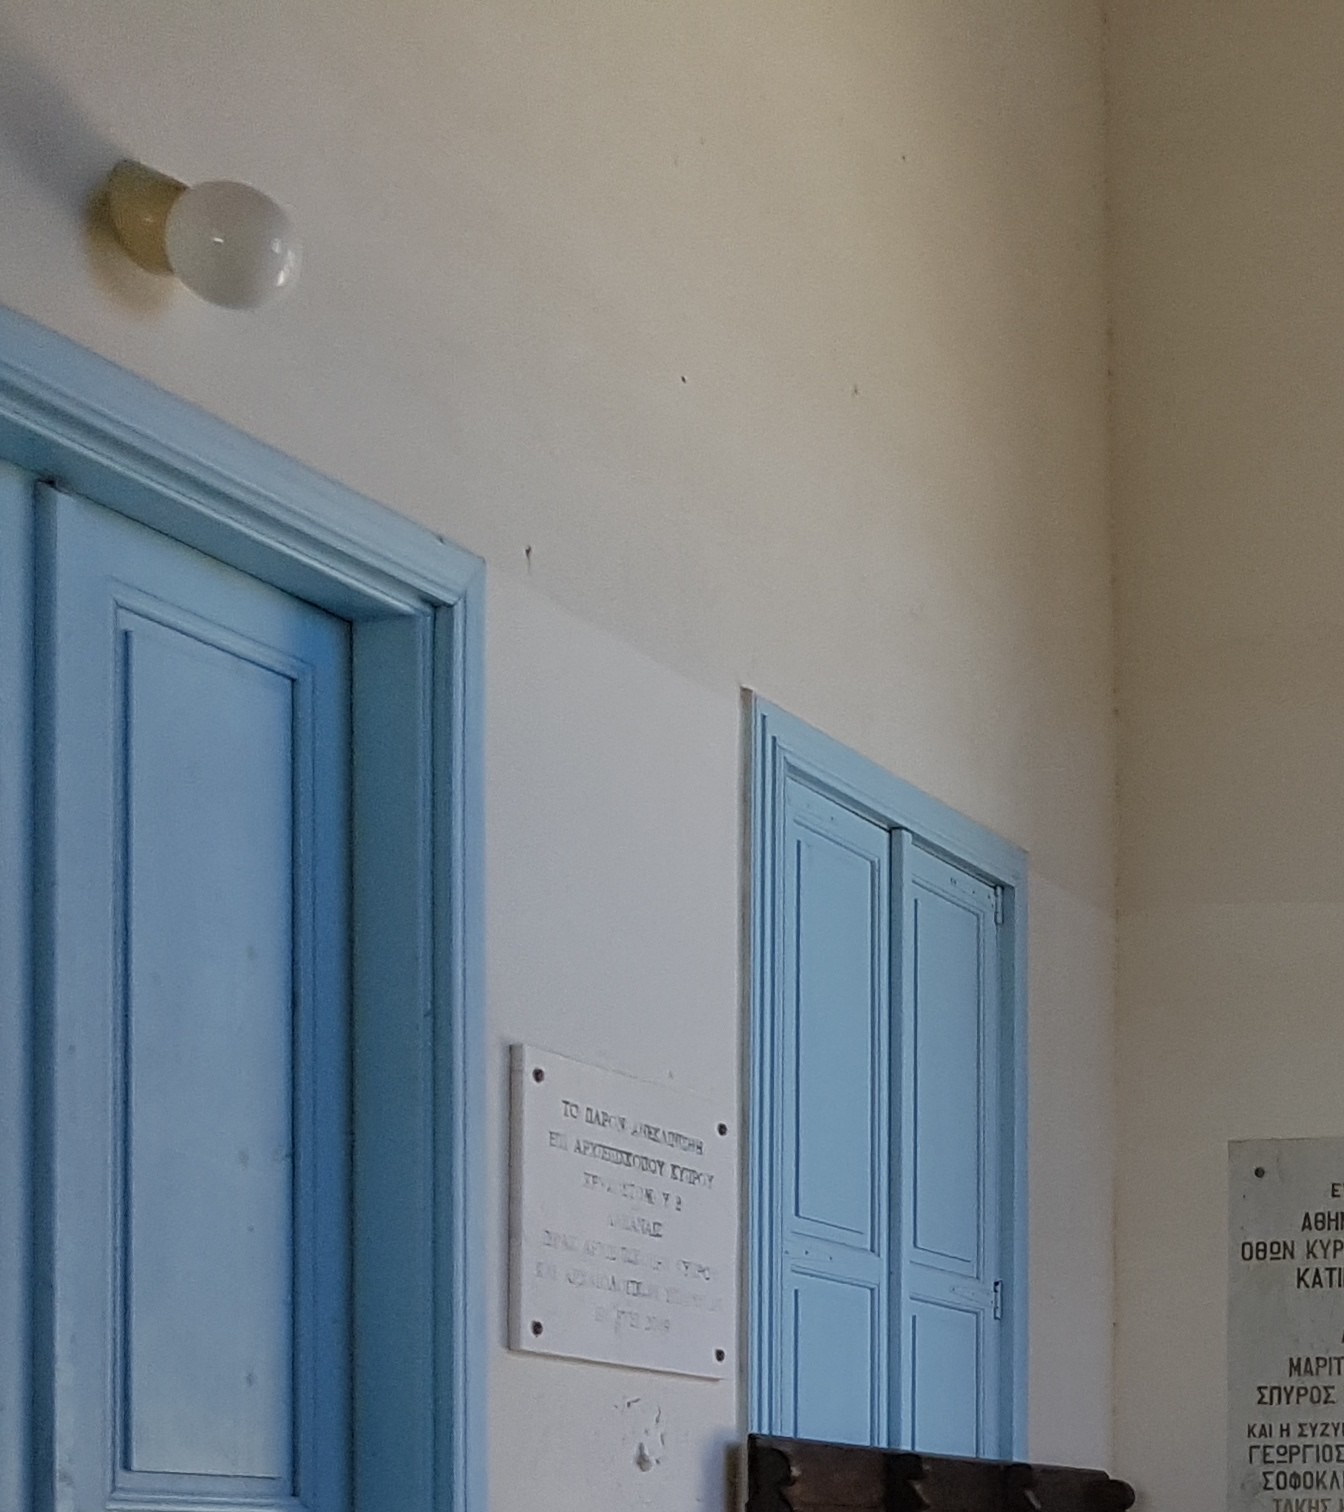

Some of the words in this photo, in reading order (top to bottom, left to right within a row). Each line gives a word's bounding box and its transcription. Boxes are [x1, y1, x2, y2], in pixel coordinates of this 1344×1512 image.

[1241, 1240, 1295, 1262] ΟΘΩΝ
[1256, 1384, 1336, 1406] ΣΠΥΡΟΣ
[1247, 1422, 1273, 1439] ΚΑΙ
[1279, 1422, 1291, 1438] Η
